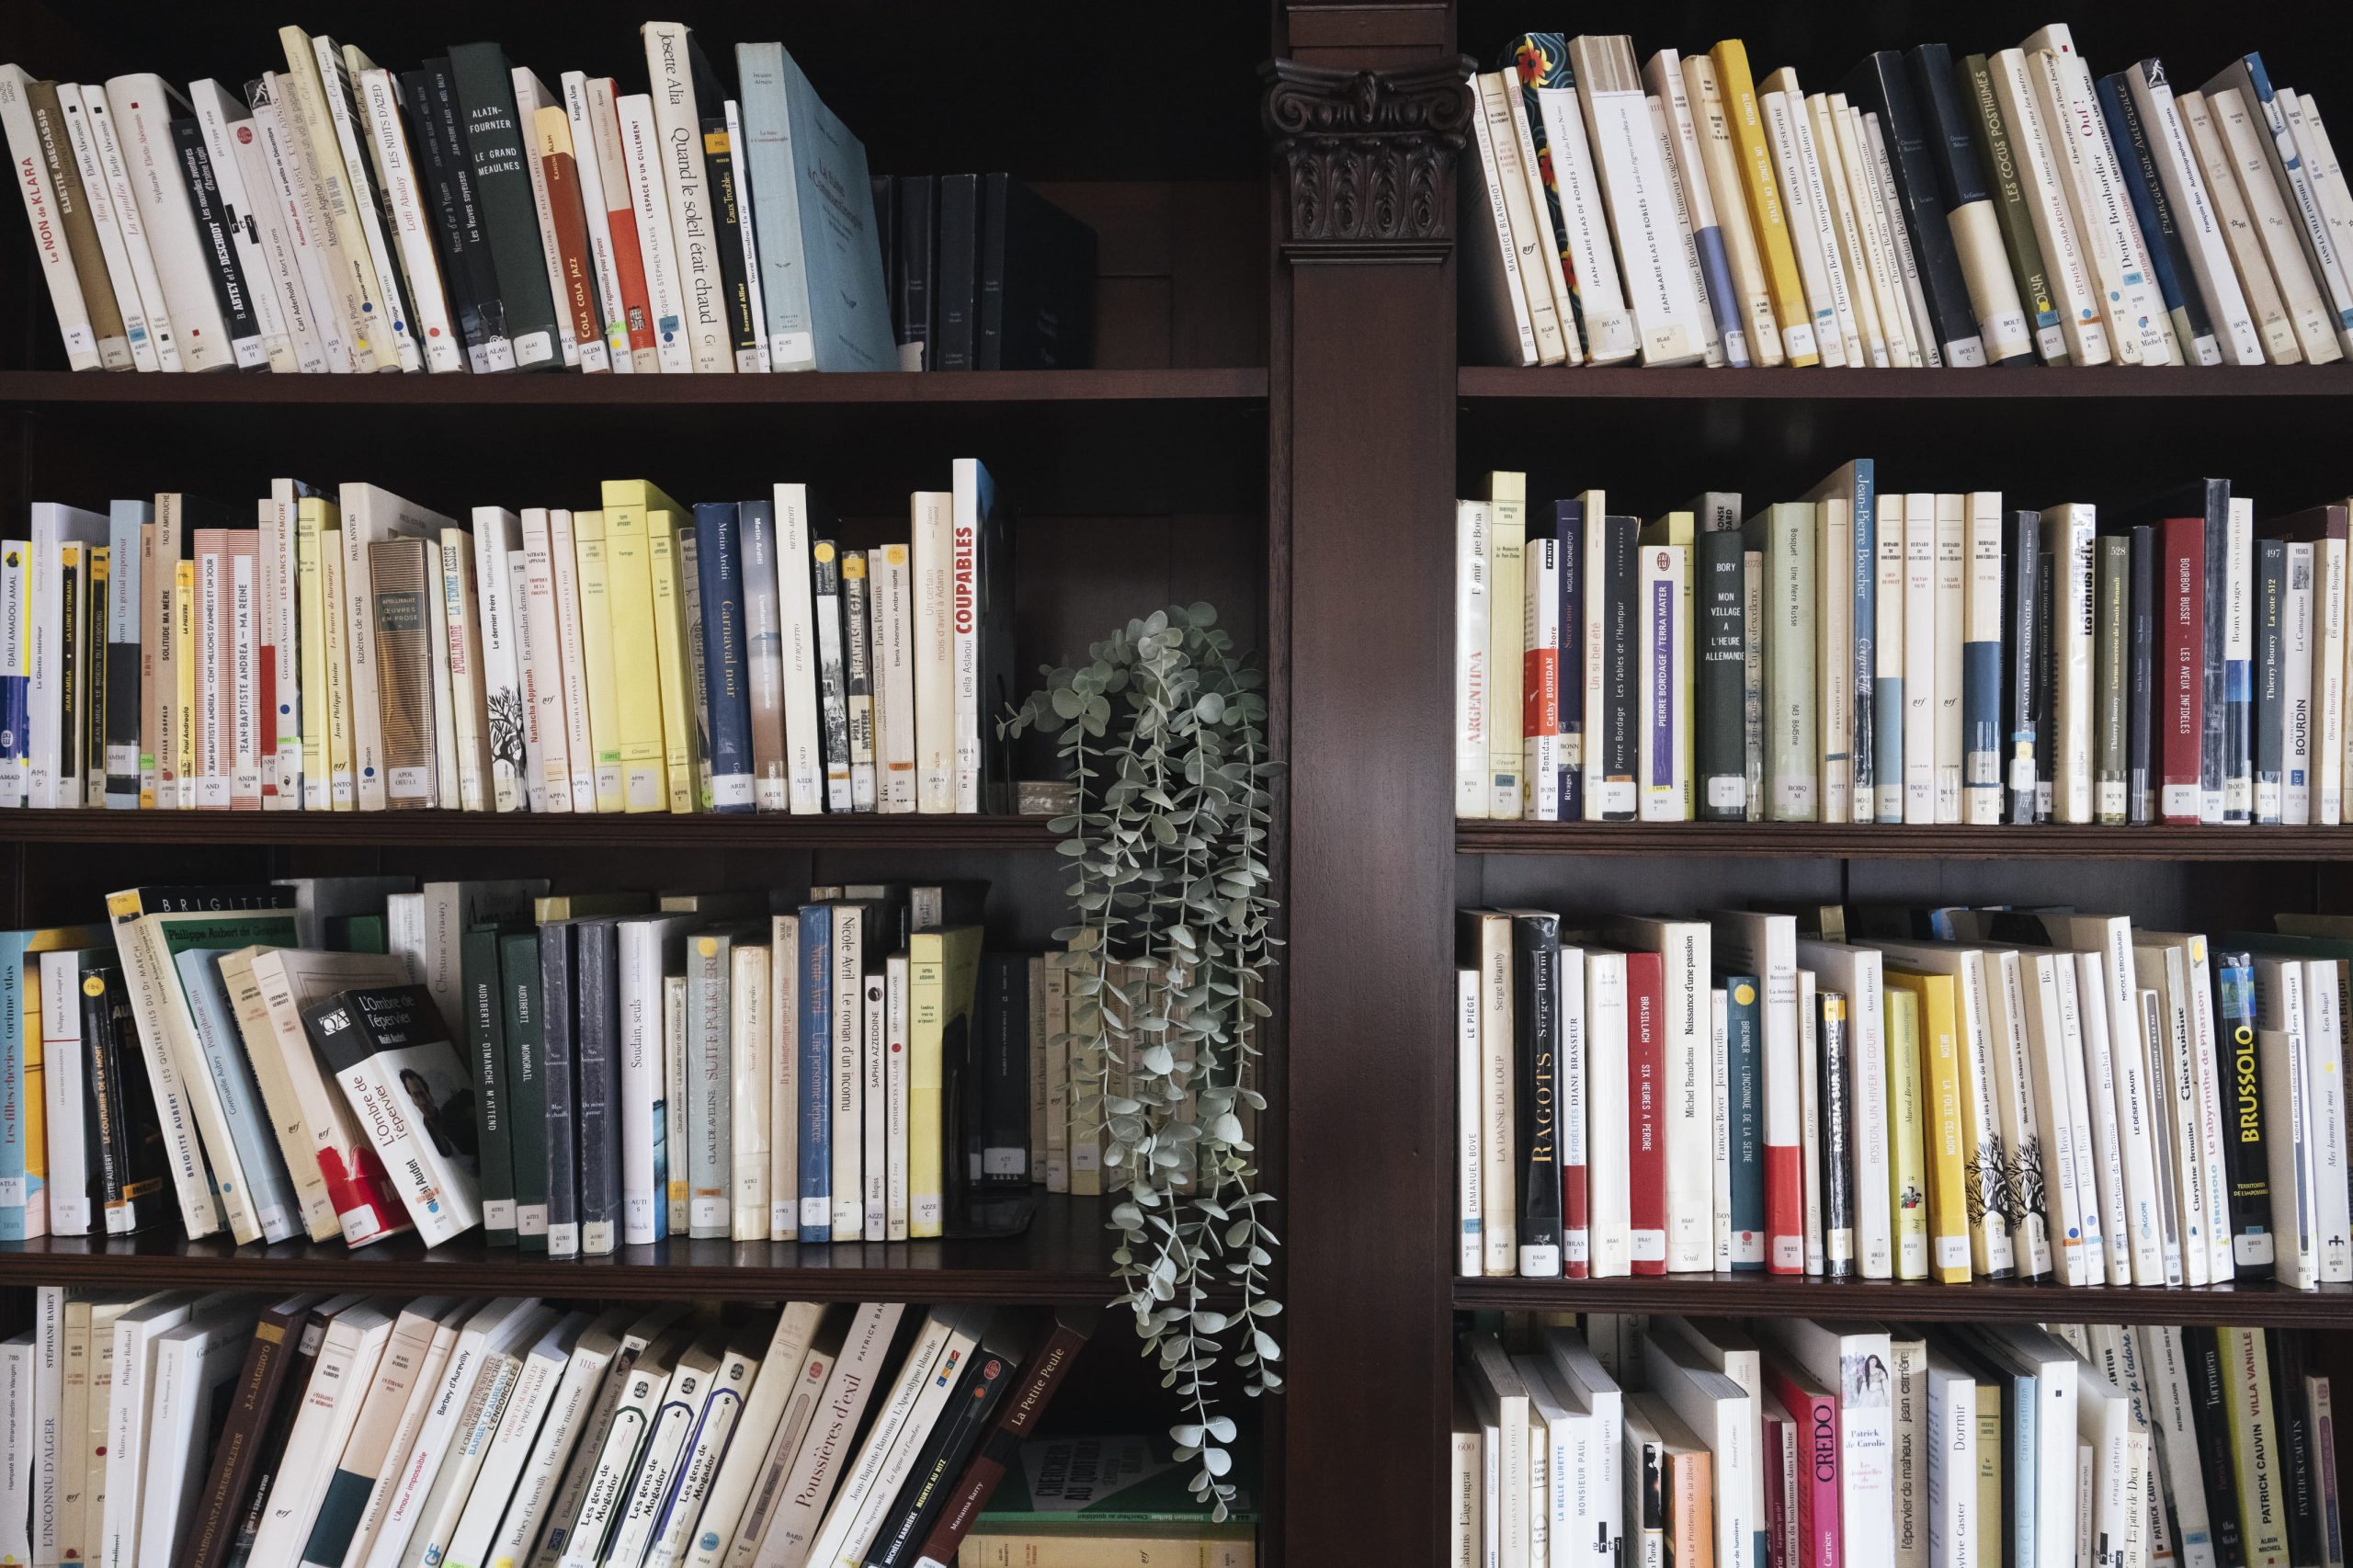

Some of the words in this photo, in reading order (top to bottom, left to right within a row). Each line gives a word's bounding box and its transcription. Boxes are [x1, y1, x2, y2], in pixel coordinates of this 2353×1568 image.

[656, 30, 677, 74] Josette
[371, 84, 388, 118] D'AZED
[666, 77, 684, 105] Alia
[1974, 71, 2003, 136] POSTHUMES
[470, 119, 512, 134] FOURNIER
[472, 107, 503, 119] ALAIN-
[37, 108, 60, 170] ABECASSIS
[380, 119, 395, 149] NUITS
[631, 120, 644, 161] CILLEMENT
[388, 151, 401, 168] LES
[474, 151, 490, 163] LE
[489, 148, 517, 158] GRAND
[478, 161, 520, 176] MEAULNES
[670, 127, 697, 180] Quand
[1994, 140, 2013, 178] COCUS
[21, 157, 42, 205] KLARA
[639, 163, 647, 181] D'UN
[54, 171, 71, 214] ELIETTE
[642, 184, 654, 219] L'ESPACE
[681, 184, 699, 196] le
[2005, 182, 2020, 202] LES
[2094, 154, 2120, 224] Bombardier
[37, 206, 46, 218] de
[683, 201, 705, 237] soleil
[1638, 198, 1651, 228] ROBLÈS
[39, 220, 55, 250] NON
[210, 222, 231, 267] DESCHODT
[1646, 230, 1654, 241] DE
[2116, 228, 2132, 268] Denise
[51, 252, 59, 263] Le
[569, 256, 582, 278] JAZZ
[689, 243, 708, 274] était
[1649, 243, 1659, 263] BLAS
[226, 281, 244, 311] ABTEY
[574, 282, 585, 307] COLA
[694, 278, 717, 324] chaud
[737, 281, 746, 302] Alliot
[1654, 265, 1671, 313] JEAN-MARIE
[236, 311, 246, 320] B.
[579, 311, 590, 338] COLA
[740, 303, 750, 332] Bernard
[1959, 347, 1976, 356] BOLT
[1857, 474, 1870, 545] Jean-Pierre
[718, 522, 727, 550] Metin
[1789, 528, 1798, 556] Bosquet
[2110, 546, 2126, 556] 528
[720, 552, 729, 579] Arditi
[1716, 562, 1736, 573] BORY
[2266, 549, 2281, 558] 497
[8, 574, 17, 599] AMAL
[955, 527, 972, 634] COUPABLES
[1858, 549, 1870, 600] Boucher
[2179, 558, 2189, 593] BOURBON
[2268, 579, 2276, 594] 512
[238, 584, 247, 608] REINE
[1658, 586, 1666, 616] MATER
[1718, 592, 1734, 602] MON
[1790, 584, 1799, 602] Mere
[7, 601, 17, 641] AMADOU
[162, 612, 169, 623] MA
[239, 612, 247, 628] MA
[1711, 607, 1741, 617] VILLAGE
[1723, 621, 1729, 631] A
[1790, 605, 1799, 627] Russe
[2179, 597, 2190, 625] BUSSET
[2267, 616, 2275, 626] La
[721, 600, 736, 664] Carnaval
[1658, 618, 1667, 646] TERRA
[1711, 636, 1741, 646] L'HEURE
[6, 642, 16, 667] DJAÏLI
[238, 642, 248, 680] ANDREA
[962, 640, 972, 673] Aslaoui
[1705, 652, 1745, 662] ALLEMANDE
[2180, 647, 2190, 662] LES
[2267, 634, 2278, 665] Bourcy
[725, 668, 734, 698] noir
[962, 676, 972, 698] Leïla
[1545, 657, 1553, 699] BONIDAN
[1658, 653, 1667, 697] BORDAGE
[2180, 665, 2190, 689] AVEUX
[2266, 666, 2277, 700] Thierry
[239, 684, 249, 753] JEAN-BAPTISTE
[1544, 701, 1556, 727] Cathy
[1658, 697, 1667, 728] PIERRE
[2180, 694, 2190, 733] INFIDELES
[2295, 699, 2306, 756] BOURDIN
[730, 783, 746, 791] ARDI
[1788, 785, 1807, 793] BOSQ
[841, 916, 855, 951] Nicole
[1685, 935, 1696, 968] passion
[841, 956, 855, 980] Avril
[1684, 969, 1694, 992] d'une
[478, 983, 490, 1028] AUDIBERTI
[842, 993, 854, 1006] Le
[1684, 993, 1694, 1035] Naissance
[841, 1010, 851, 1042] roman
[1640, 996, 1650, 1043] BRASILLACH
[841, 1046, 854, 1068] d'un
[1570, 1017, 1578, 1069] BRASSEUR
[482, 1042, 494, 1085] DIMANCHE
[1641, 1064, 1650, 1078] SIX
[1685, 1047, 1694, 1087] Braudeau
[354, 1075, 368, 1093] de
[841, 1072, 854, 1111] inconnu
[1642, 1082, 1651, 1109] HEURES
[2235, 1025, 2259, 1142] BRUSSOLO
[167, 1093, 183, 1129] AUBERT
[374, 1085, 409, 1142] l'épervier
[486, 1090, 496, 1131] M'ATTEND
[1532, 1053, 1552, 1163] RAGOTS
[1685, 1090, 1694, 1118] Michel
[364, 1094, 395, 1148] L'Ombre
[1642, 1123, 1651, 1151] PERDRE
[177, 1133, 194, 1177] BRIGITTE
[1565, 1239, 1586, 1249] BRAS
[2243, 1331, 2256, 1380] VANILLE
[437, 1389, 454, 1415] Barbey
[449, 1349, 471, 1389] d'Aurevilly
[1011, 1412, 1026, 1426] La
[1020, 1380, 1045, 1411] Petite
[1040, 1348, 1064, 1378] Peule
[1894, 1351, 1911, 1394] carrière
[1899, 1397, 1913, 1423] jean
[2248, 1382, 2260, 1416] VILLA
[794, 1421, 842, 1507] Poussières
[832, 1373, 861, 1418] d'exil
[1953, 1403, 1965, 1450] Dormir
[43, 1417, 54, 1471] D'ALGER
[1815, 1403, 1835, 1483] CREDO
[1899, 1433, 1912, 1480] maheux
[2252, 1424, 2266, 1470] CAUVIN
[629, 1504, 641, 1519] Les
[639, 1473, 653, 1498] gens
[648, 1459, 658, 1471] de
[642, 1468, 666, 1517] Mogador
[1900, 1481, 1912, 1496] de
[2257, 1472, 2271, 1524] PATRICK
[43, 1476, 53, 1547] L'INCONNU
[1900, 1497, 1915, 1549] l'épervier
